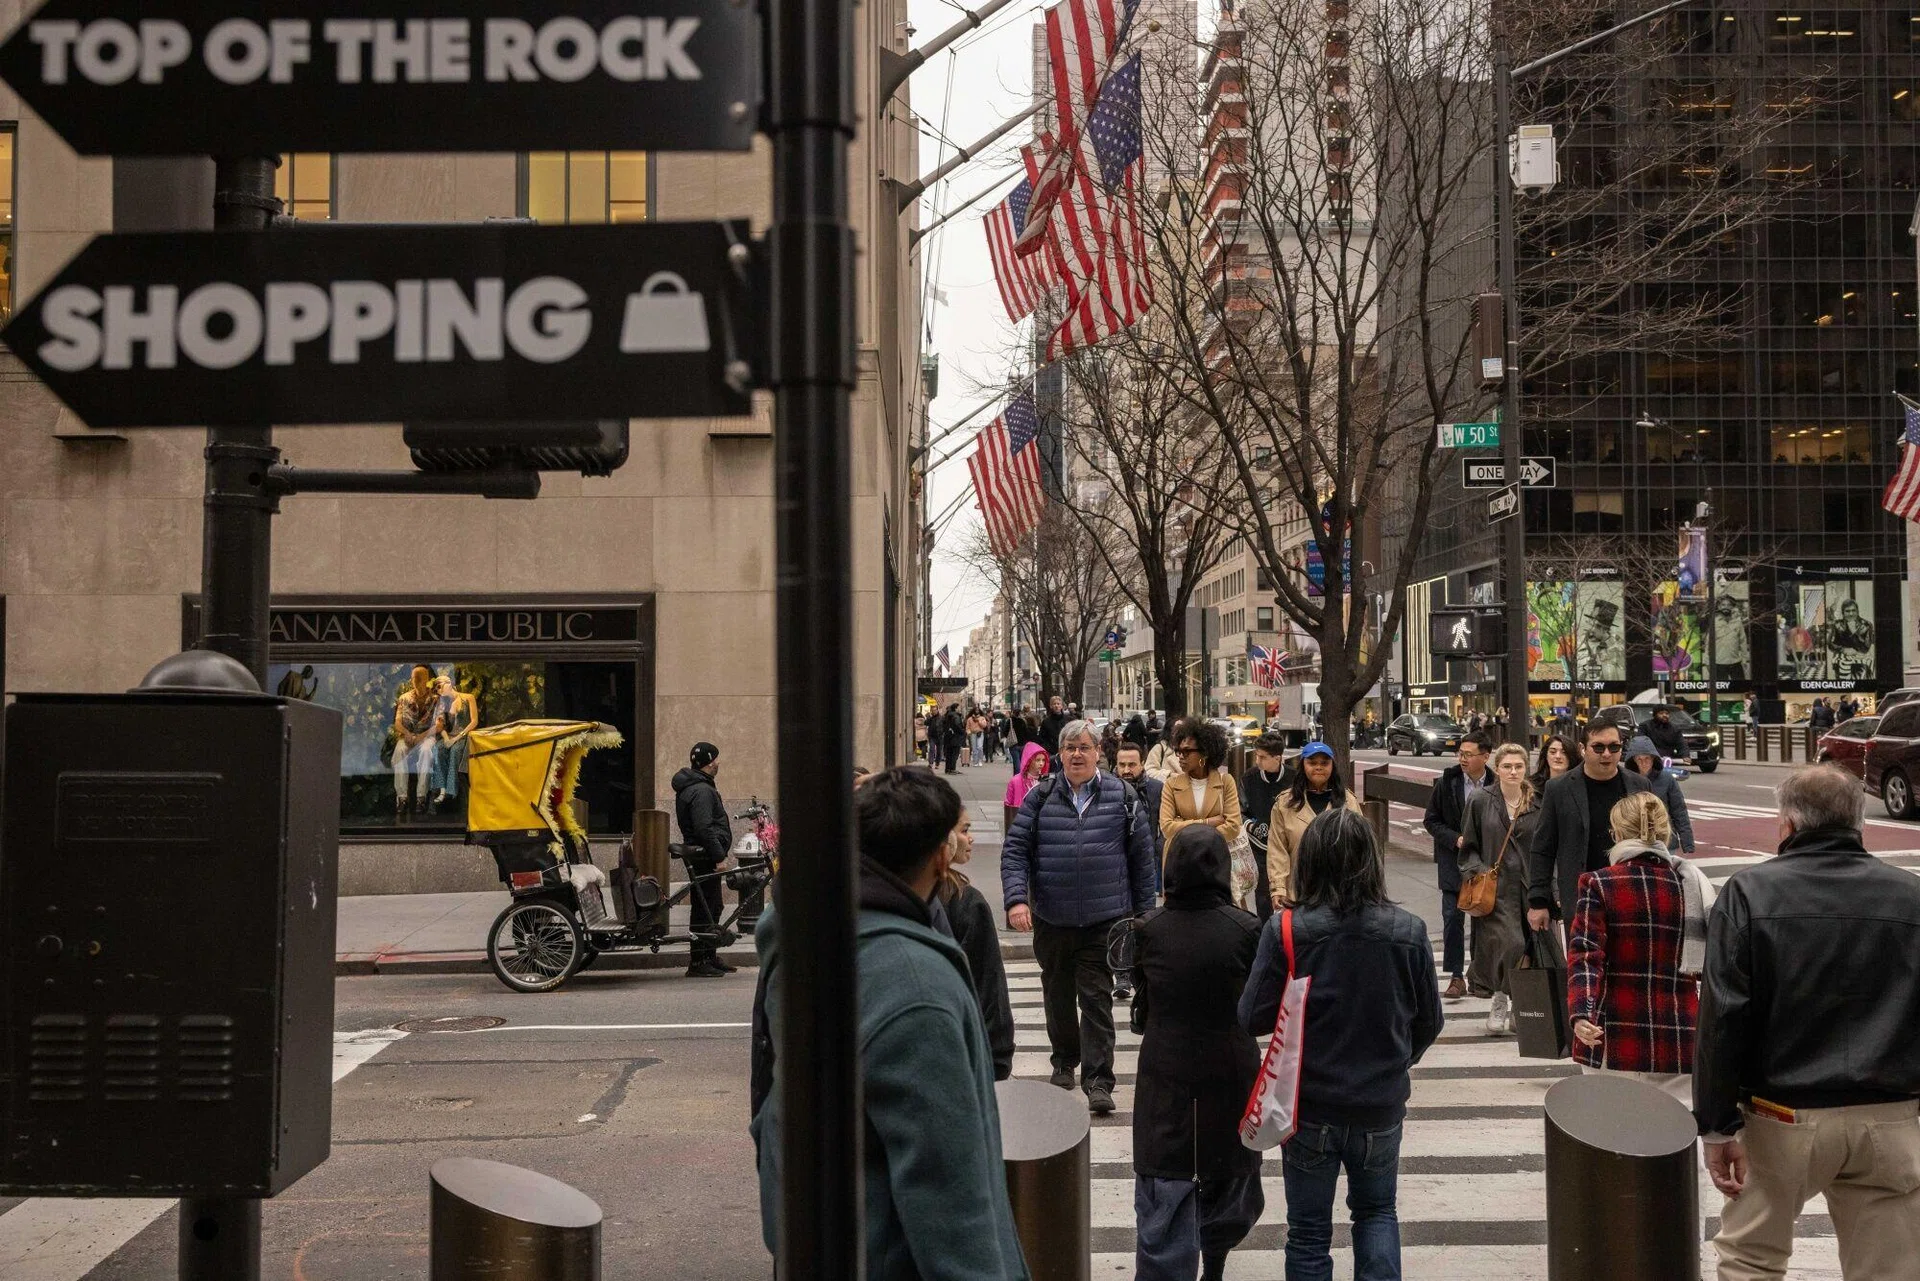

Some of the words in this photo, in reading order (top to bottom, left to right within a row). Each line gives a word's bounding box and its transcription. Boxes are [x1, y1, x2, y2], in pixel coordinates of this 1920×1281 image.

[29, 18, 192, 84] TOP
[203, 18, 311, 84] OF
[323, 18, 469, 83] THE
[485, 16, 702, 82] ROCK
[38, 275, 592, 371] SHOPPING
[1455, 428, 1464, 443] W
[1470, 426, 1485, 443] 50
[1489, 426, 1498, 437] St
[1477, 467, 1502, 479] ONE
[270, 614, 404, 641] ANANA
[417, 612, 593, 641] REPUBLIC
[1550, 682, 1571, 690] EDEN
[1675, 682, 1696, 690] EDEN
[1696, 682, 1730, 690] GAERY
[1801, 681, 1822, 689] EDEN
[1822, 681, 1856, 689] GALLERY
